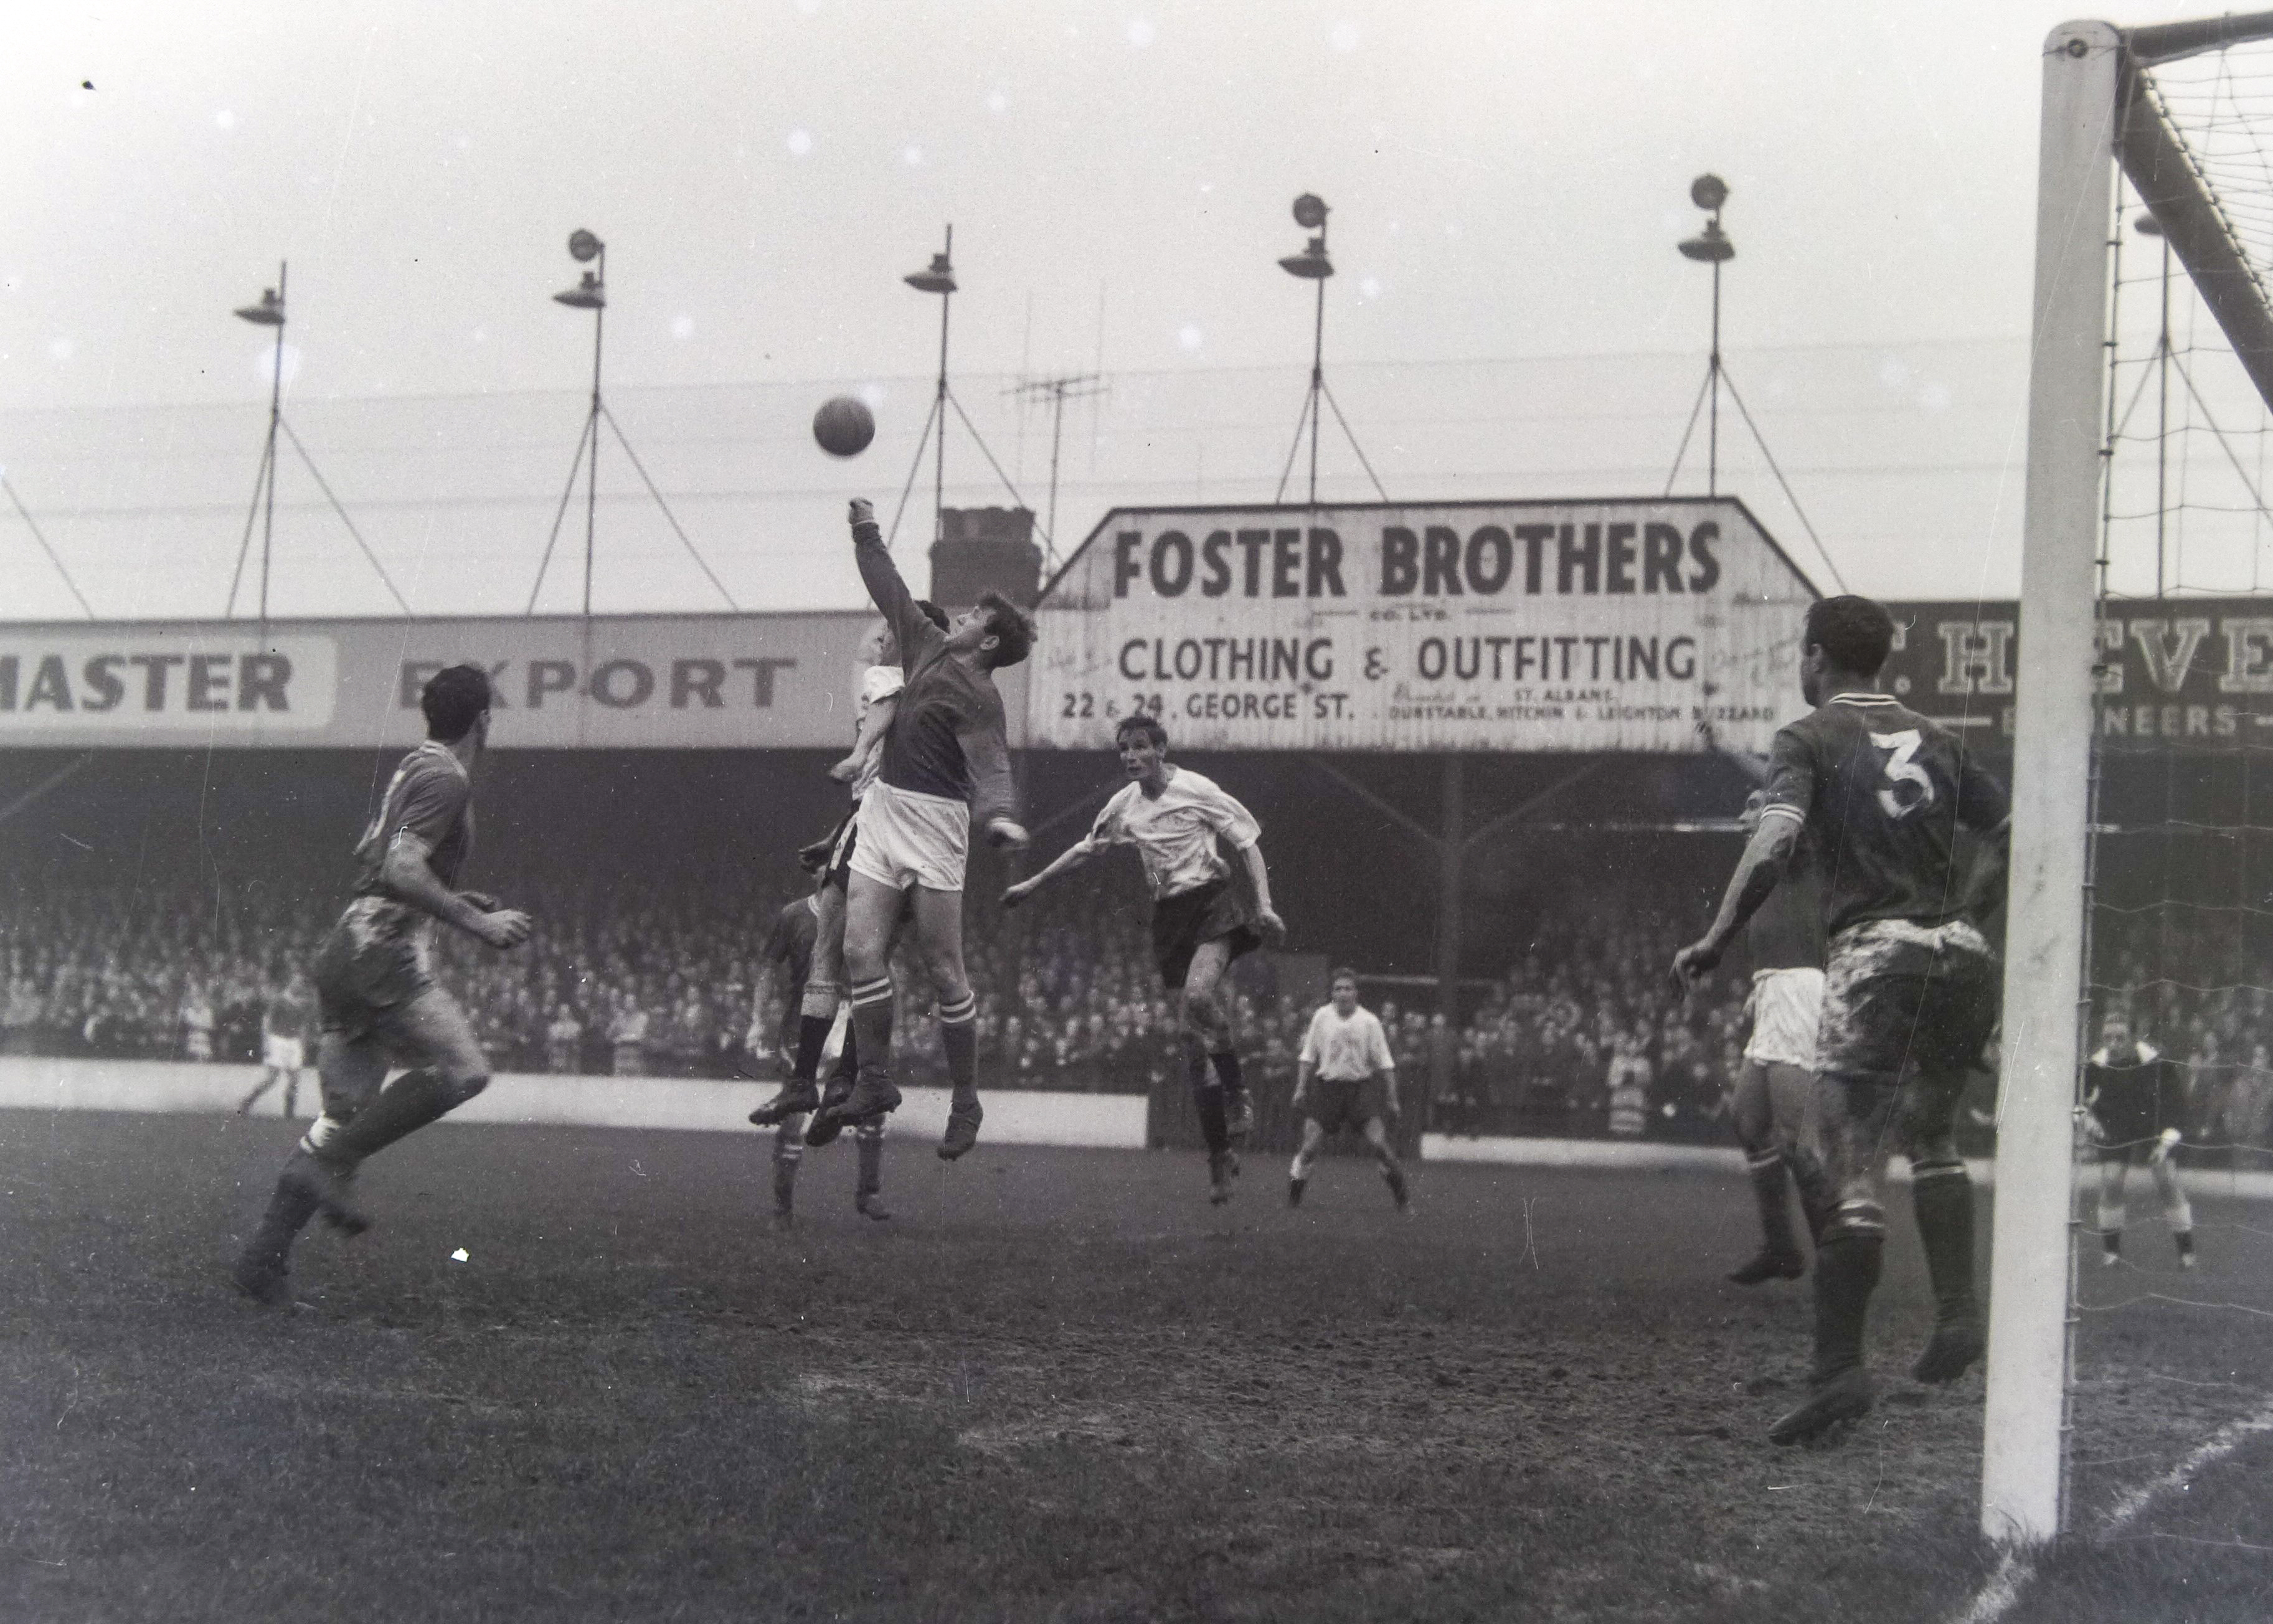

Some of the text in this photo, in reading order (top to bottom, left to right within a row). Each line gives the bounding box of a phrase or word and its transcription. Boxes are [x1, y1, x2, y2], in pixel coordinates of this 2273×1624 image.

[1115, 522, 1721, 598] FOSTER BROTHERS
[0, 654, 293, 712] ASTER
[1120, 638, 1333, 680] CLOTHING
[1364, 648, 1389, 680] &
[1418, 636, 1696, 680] OUTFITTING
[1061, 692, 1094, 719] 22
[1186, 691, 1298, 719] GEORGE
[1314, 691, 1354, 720] ST.
[2003, 704, 2237, 736] ENEERS
[1869, 729, 1935, 819] 3
